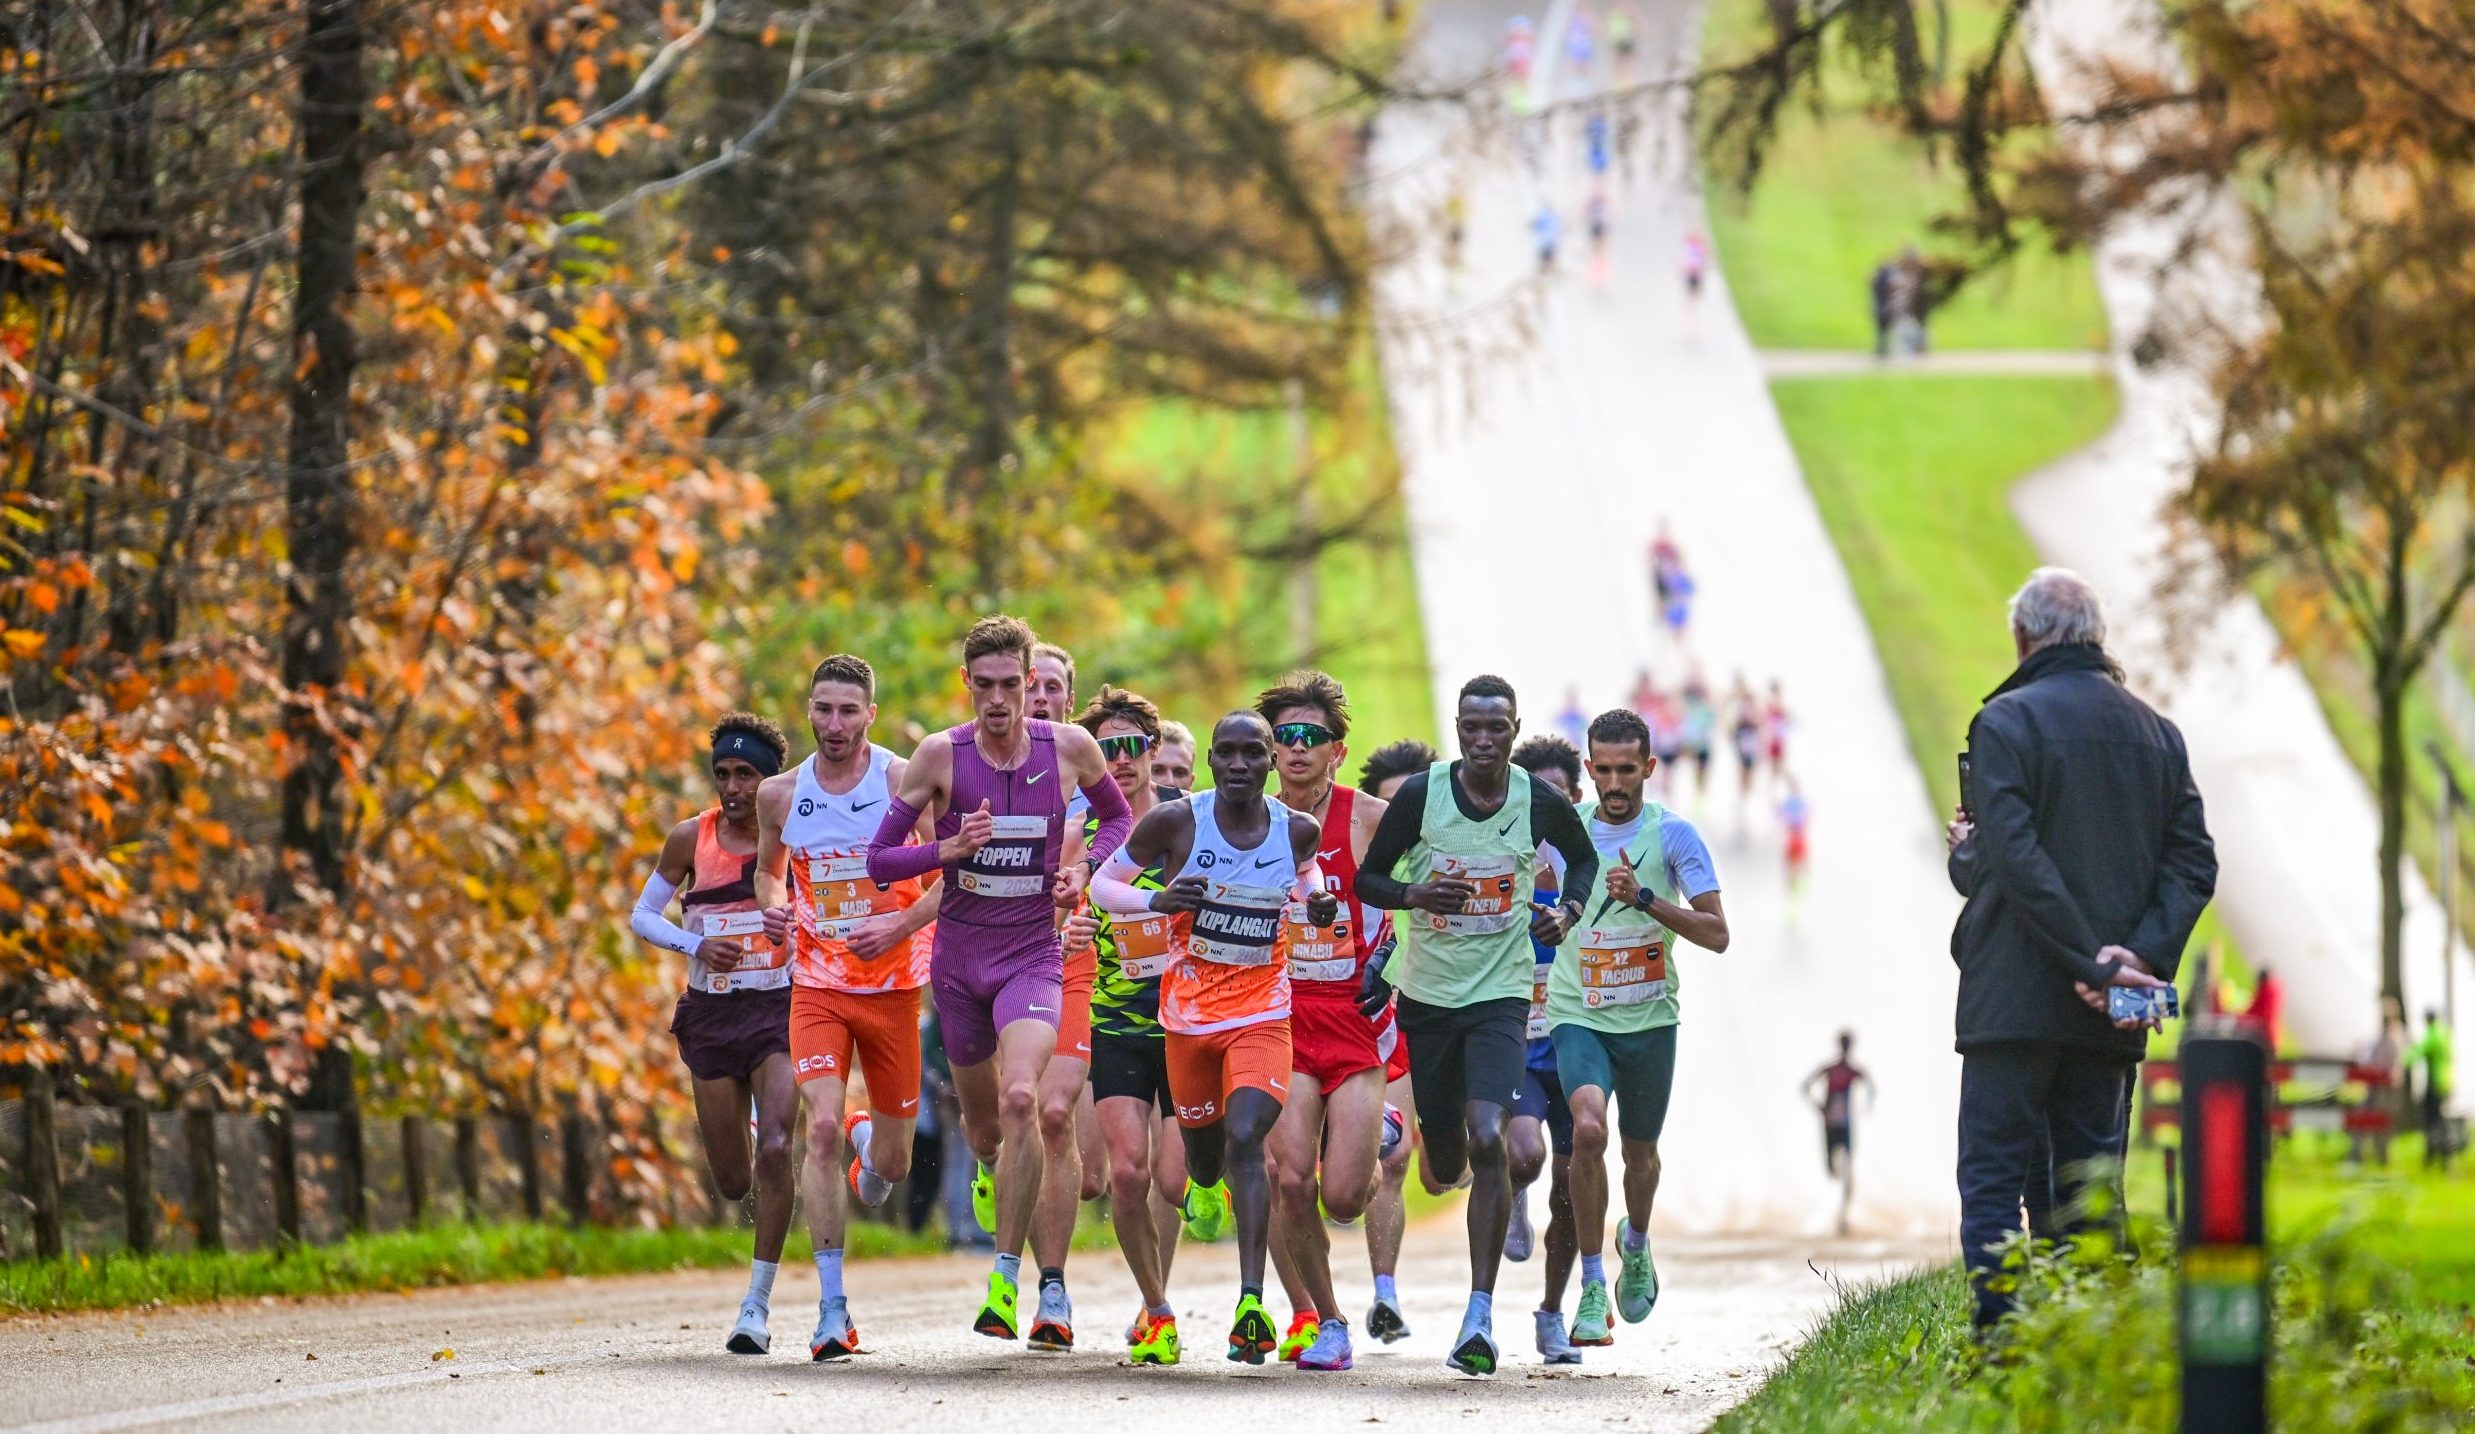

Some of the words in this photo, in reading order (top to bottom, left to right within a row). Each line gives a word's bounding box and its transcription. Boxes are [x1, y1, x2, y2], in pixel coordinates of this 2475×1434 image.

[816, 802, 828, 810] NN
[973, 846, 1033, 867] FOPPEN
[1219, 857, 1233, 865] NN
[846, 882, 857, 897] 3
[1214, 884, 1226, 899] 7
[839, 899, 872, 917] MARC
[838, 926, 851, 934] NN
[1142, 920, 1161, 937] 66
[1196, 908, 1277, 938] KIPLANGAT
[1450, 920, 1463, 928] NN
[1301, 926, 1318, 940] 19
[1591, 930, 1602, 945] 7
[1210, 948, 1222, 956] NN
[1612, 949, 1629, 966] 12
[1141, 963, 1154, 971] NN
[1600, 965, 1646, 985] YACOUB
